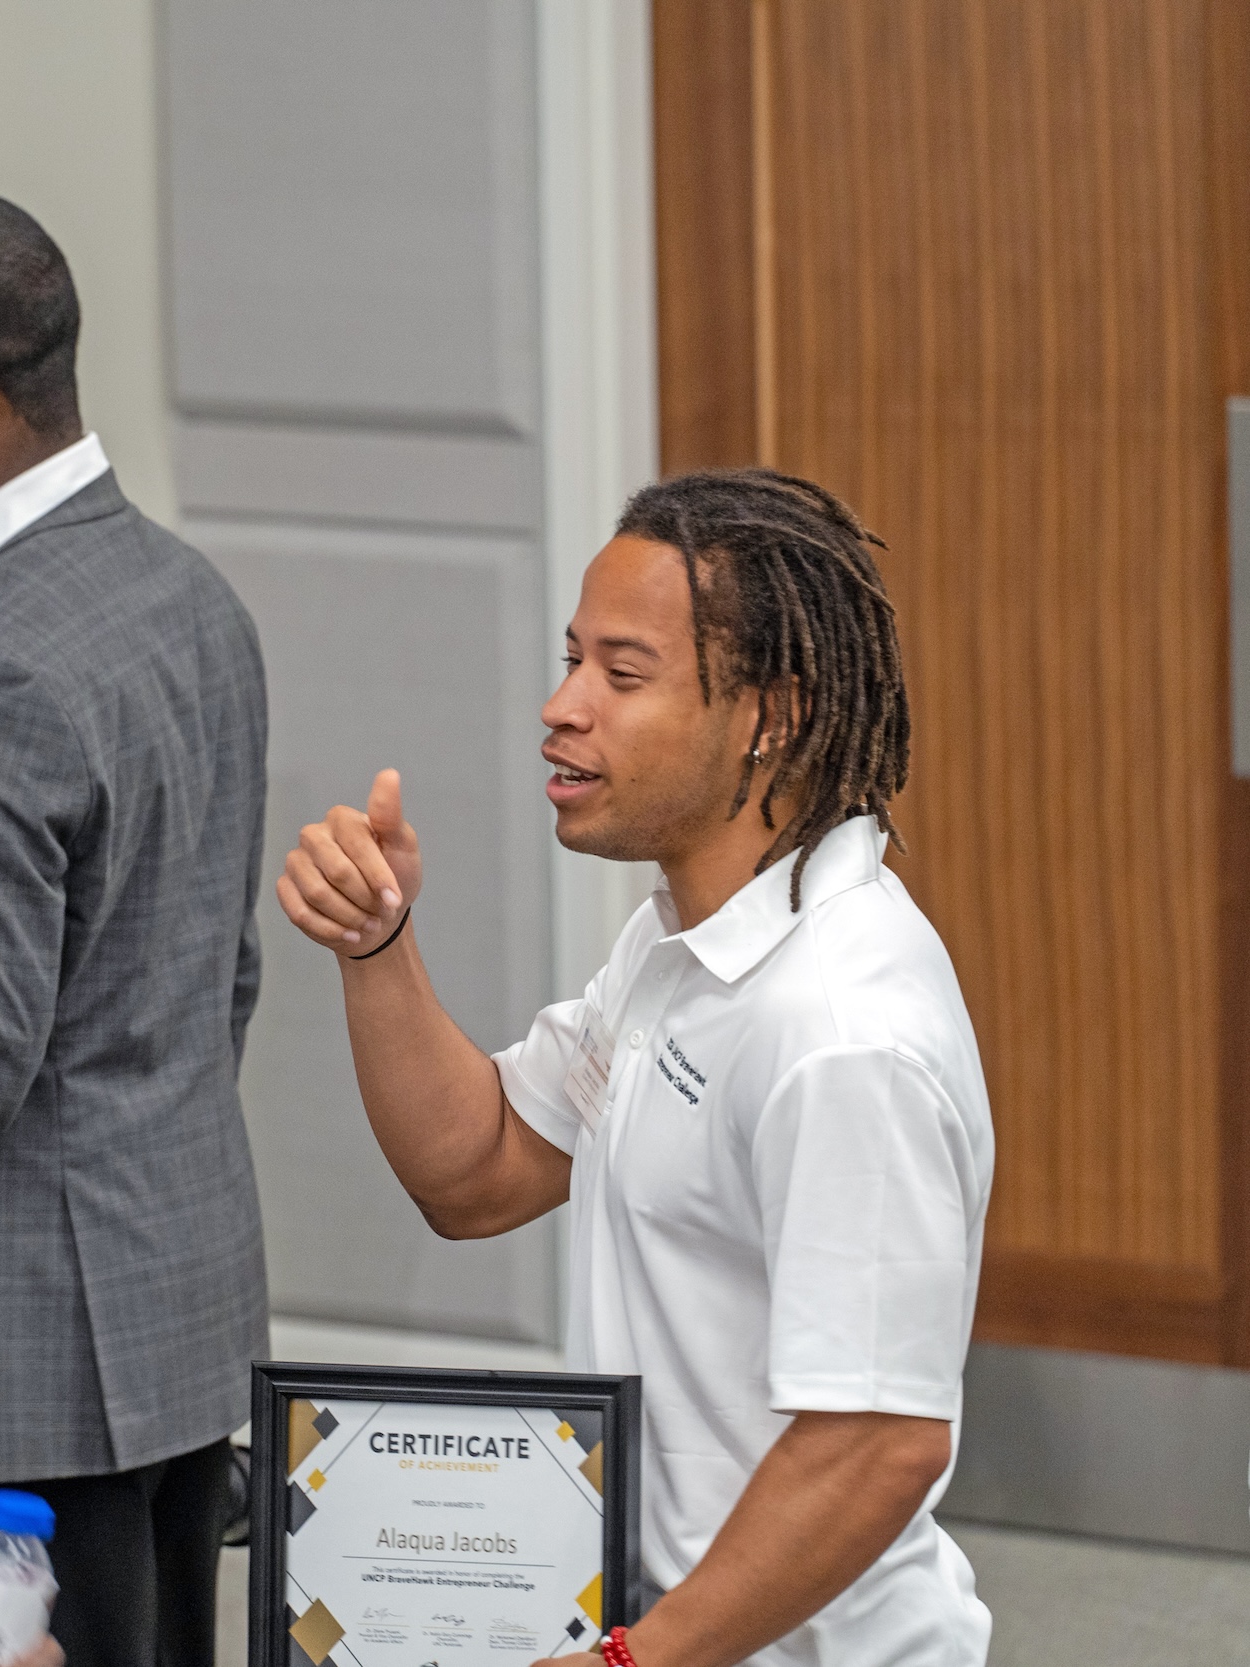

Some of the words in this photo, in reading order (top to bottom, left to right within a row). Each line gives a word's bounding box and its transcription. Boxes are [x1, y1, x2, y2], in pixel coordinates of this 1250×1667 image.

[369, 1431, 530, 1459] CERTIFICATE
[399, 1459, 414, 1469] OF
[418, 1460, 500, 1473] ACHIEVEMENT
[376, 1527, 445, 1554] Alaqua
[450, 1531, 518, 1554] Jacobs
[361, 1574, 385, 1583] UNCP
[387, 1575, 434, 1585] BraveHawk
[436, 1577, 491, 1589] Entrepreneur
[493, 1579, 535, 1592] Challenge
